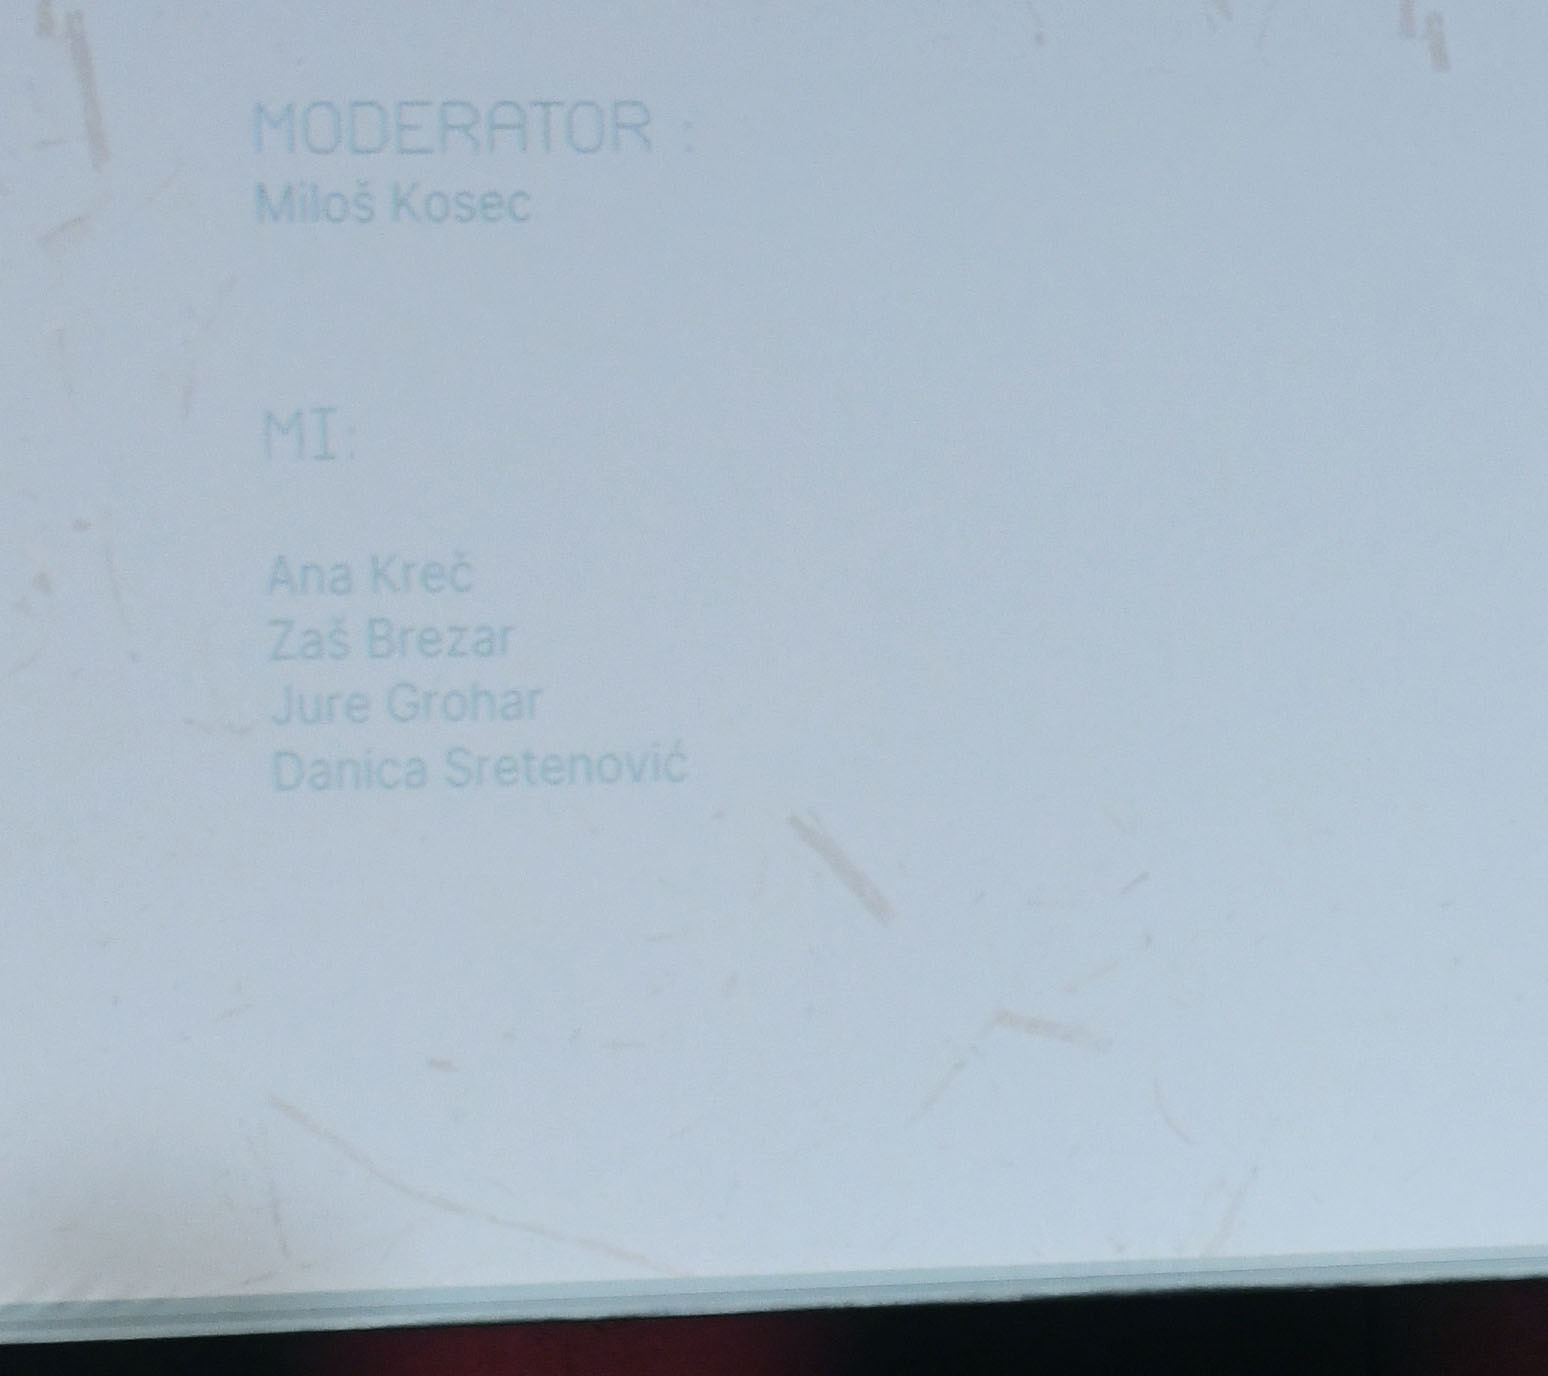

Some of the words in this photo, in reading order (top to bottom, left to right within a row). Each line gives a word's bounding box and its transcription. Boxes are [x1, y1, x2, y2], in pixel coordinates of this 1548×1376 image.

[256, 181, 375, 224] Miloš
[391, 183, 532, 224] Kosec
[267, 555, 353, 596] Ana
[370, 549, 474, 595] Kreč
[268, 617, 350, 661] Zaš
[367, 618, 514, 658] Brezar
[271, 684, 371, 725] Jure
[387, 685, 543, 723] Grohar
[272, 749, 427, 792] Danica
[444, 739, 689, 788] Sretenović
